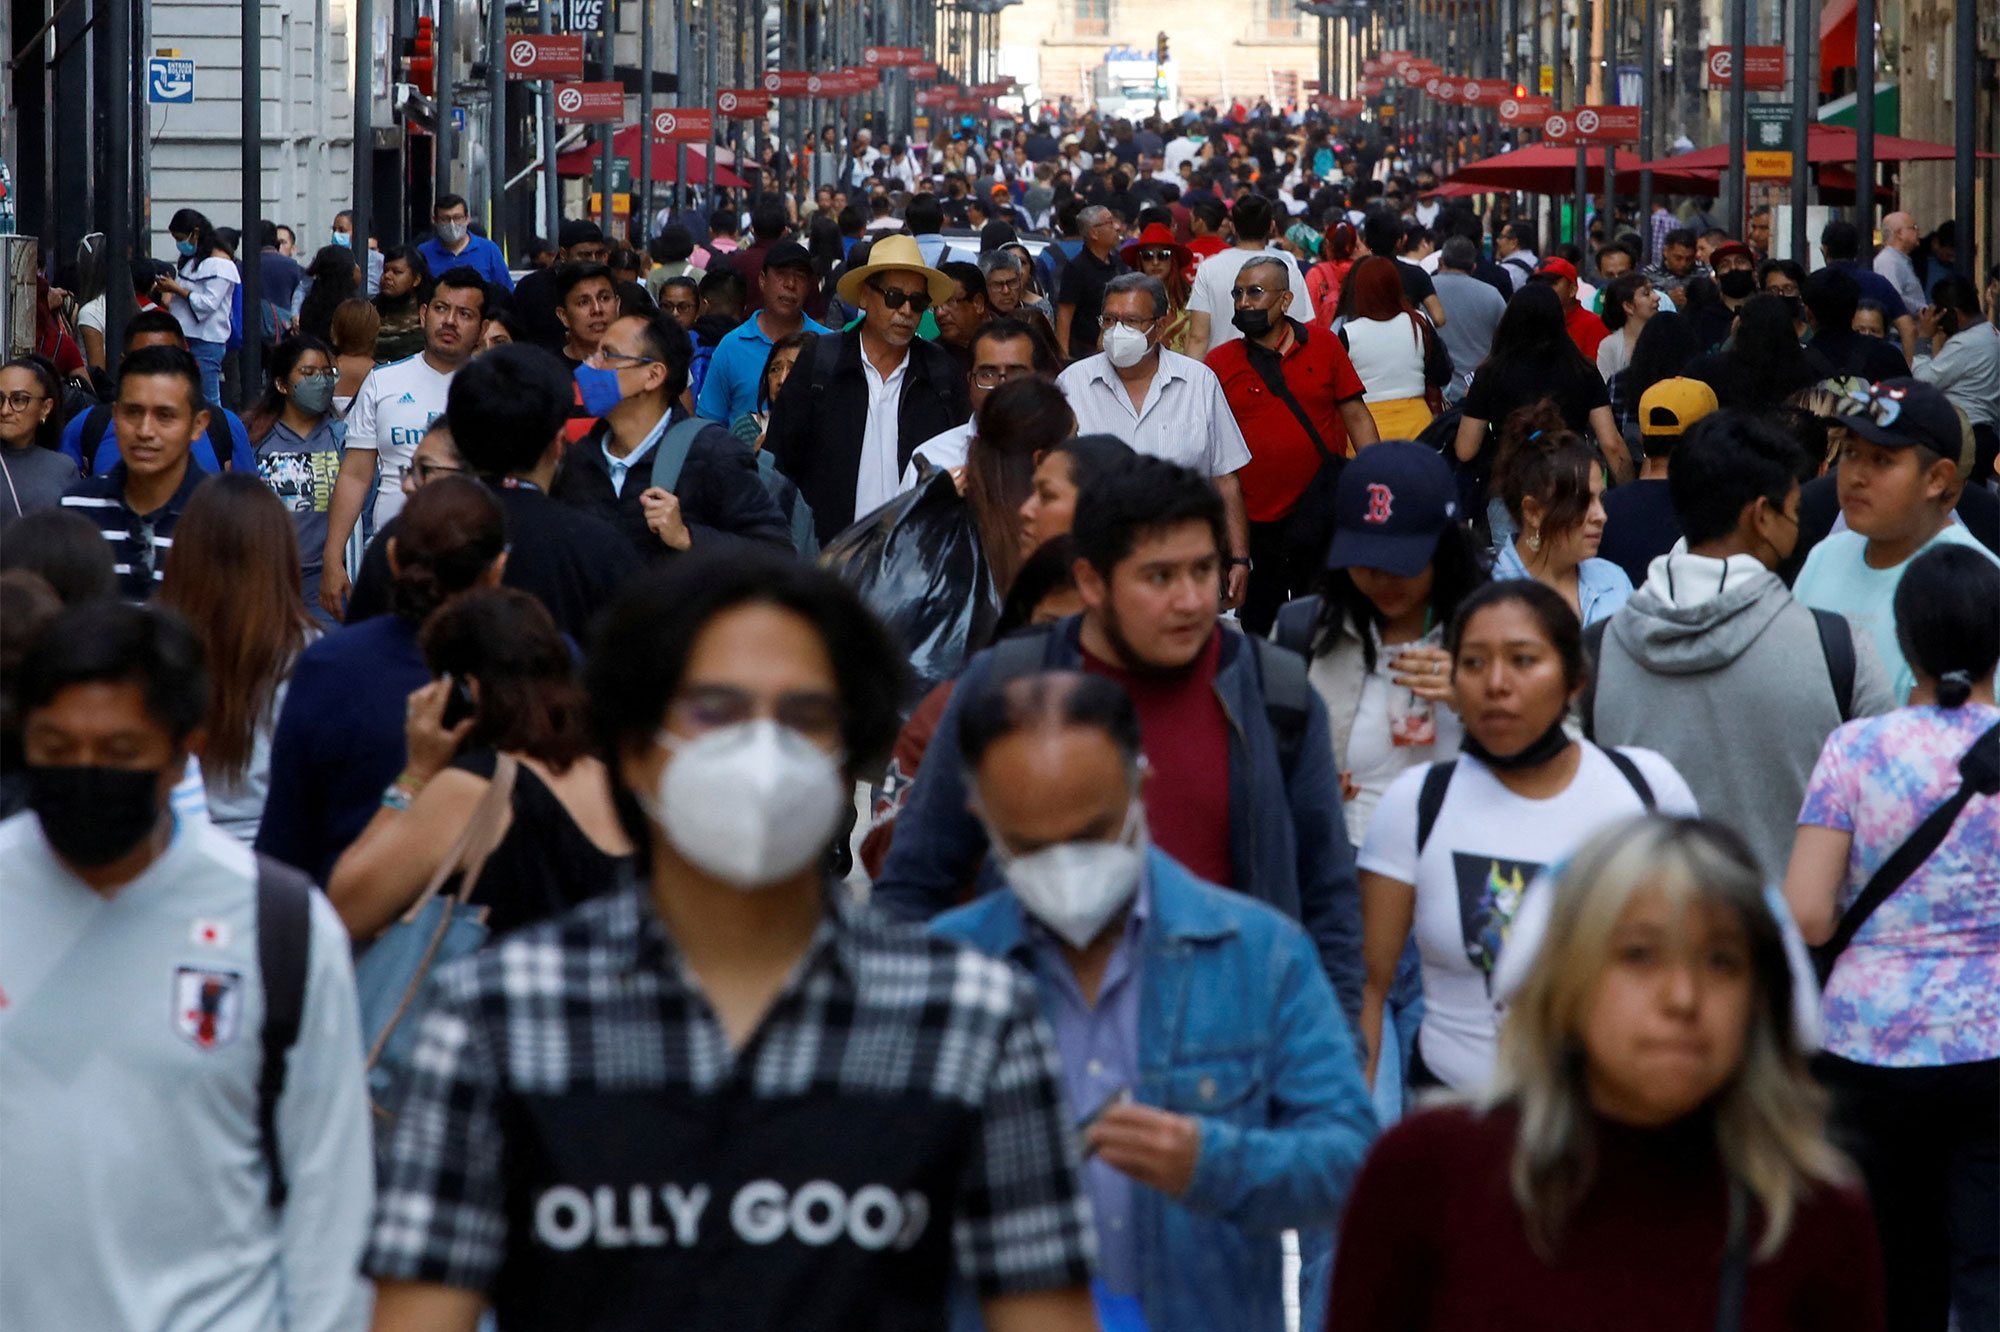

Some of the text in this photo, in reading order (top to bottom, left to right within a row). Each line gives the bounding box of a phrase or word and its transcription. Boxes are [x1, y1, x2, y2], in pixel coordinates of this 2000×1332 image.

[574, 1, 603, 14] VIC
[574, 15, 599, 30] US
[312, 451, 329, 512] MOTION
[1363, 483, 1395, 525] B
[534, 1182, 711, 1251] OLLY
